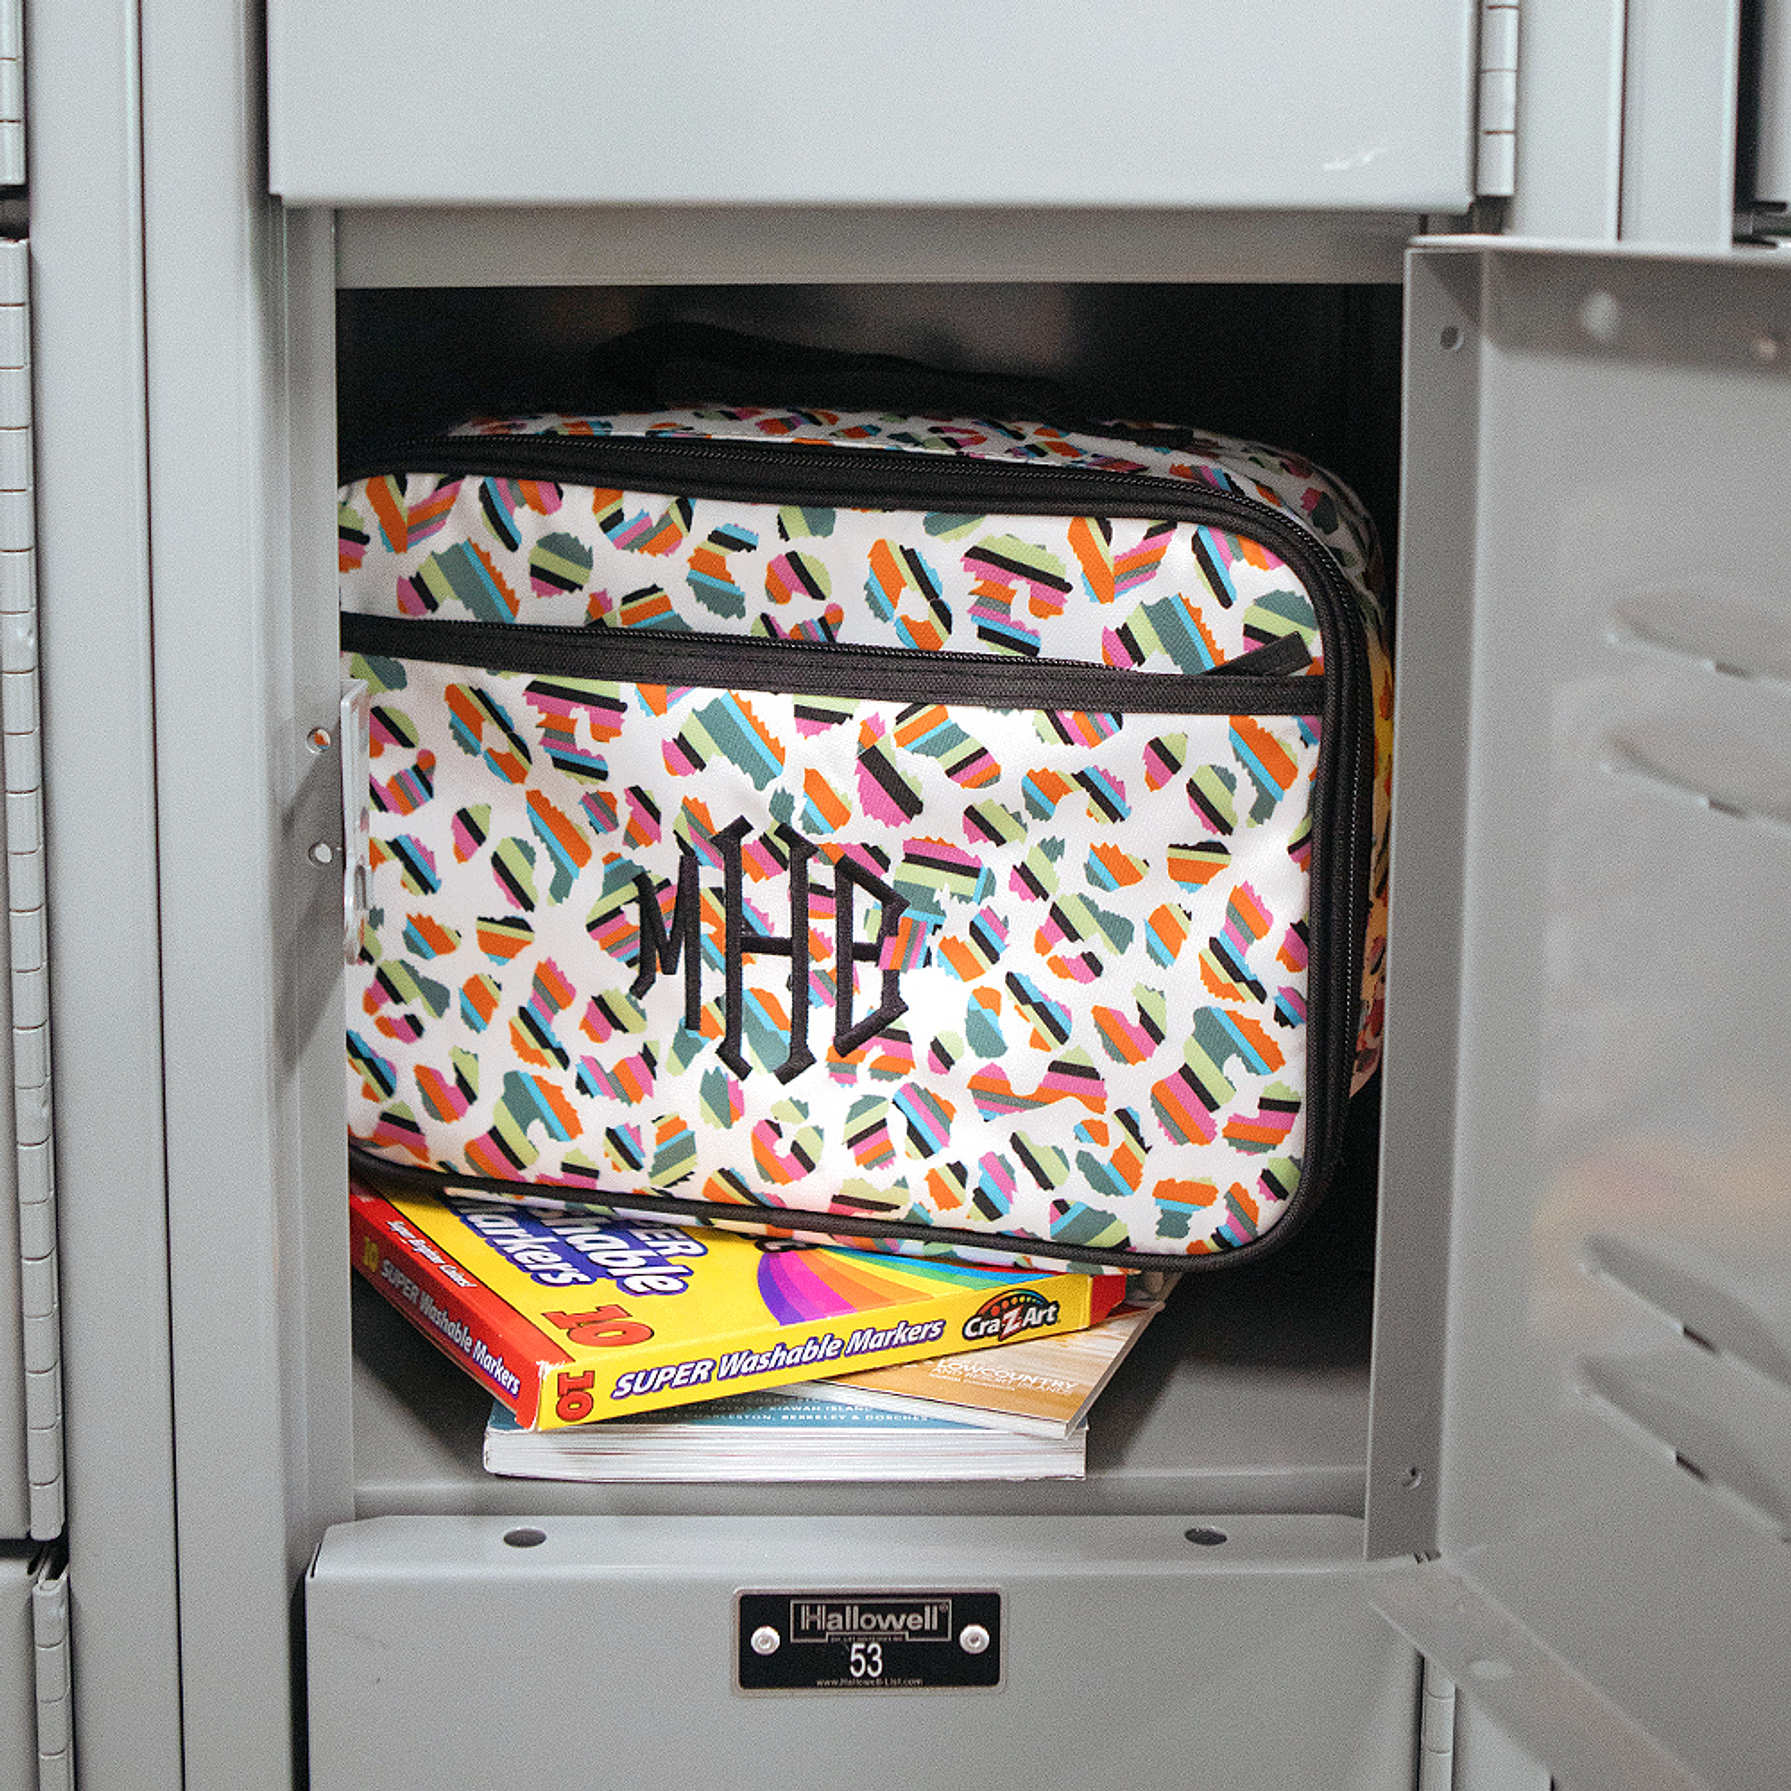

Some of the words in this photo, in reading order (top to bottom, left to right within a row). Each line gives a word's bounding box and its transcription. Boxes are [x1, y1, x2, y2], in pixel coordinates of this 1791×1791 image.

[381, 1258, 421, 1304] SUPER
[418, 1290, 474, 1355] Washable
[472, 1340, 521, 1399] Markers
[541, 1304, 655, 1347] 10
[556, 1370, 596, 1421] 10
[612, 1358, 715, 1399] SUPER
[718, 1334, 844, 1380] Washable
[845, 1319, 946, 1356] Markers
[936, 1358, 1079, 1390] LOWCOUNTRY
[849, 1642, 883, 1678] 53
